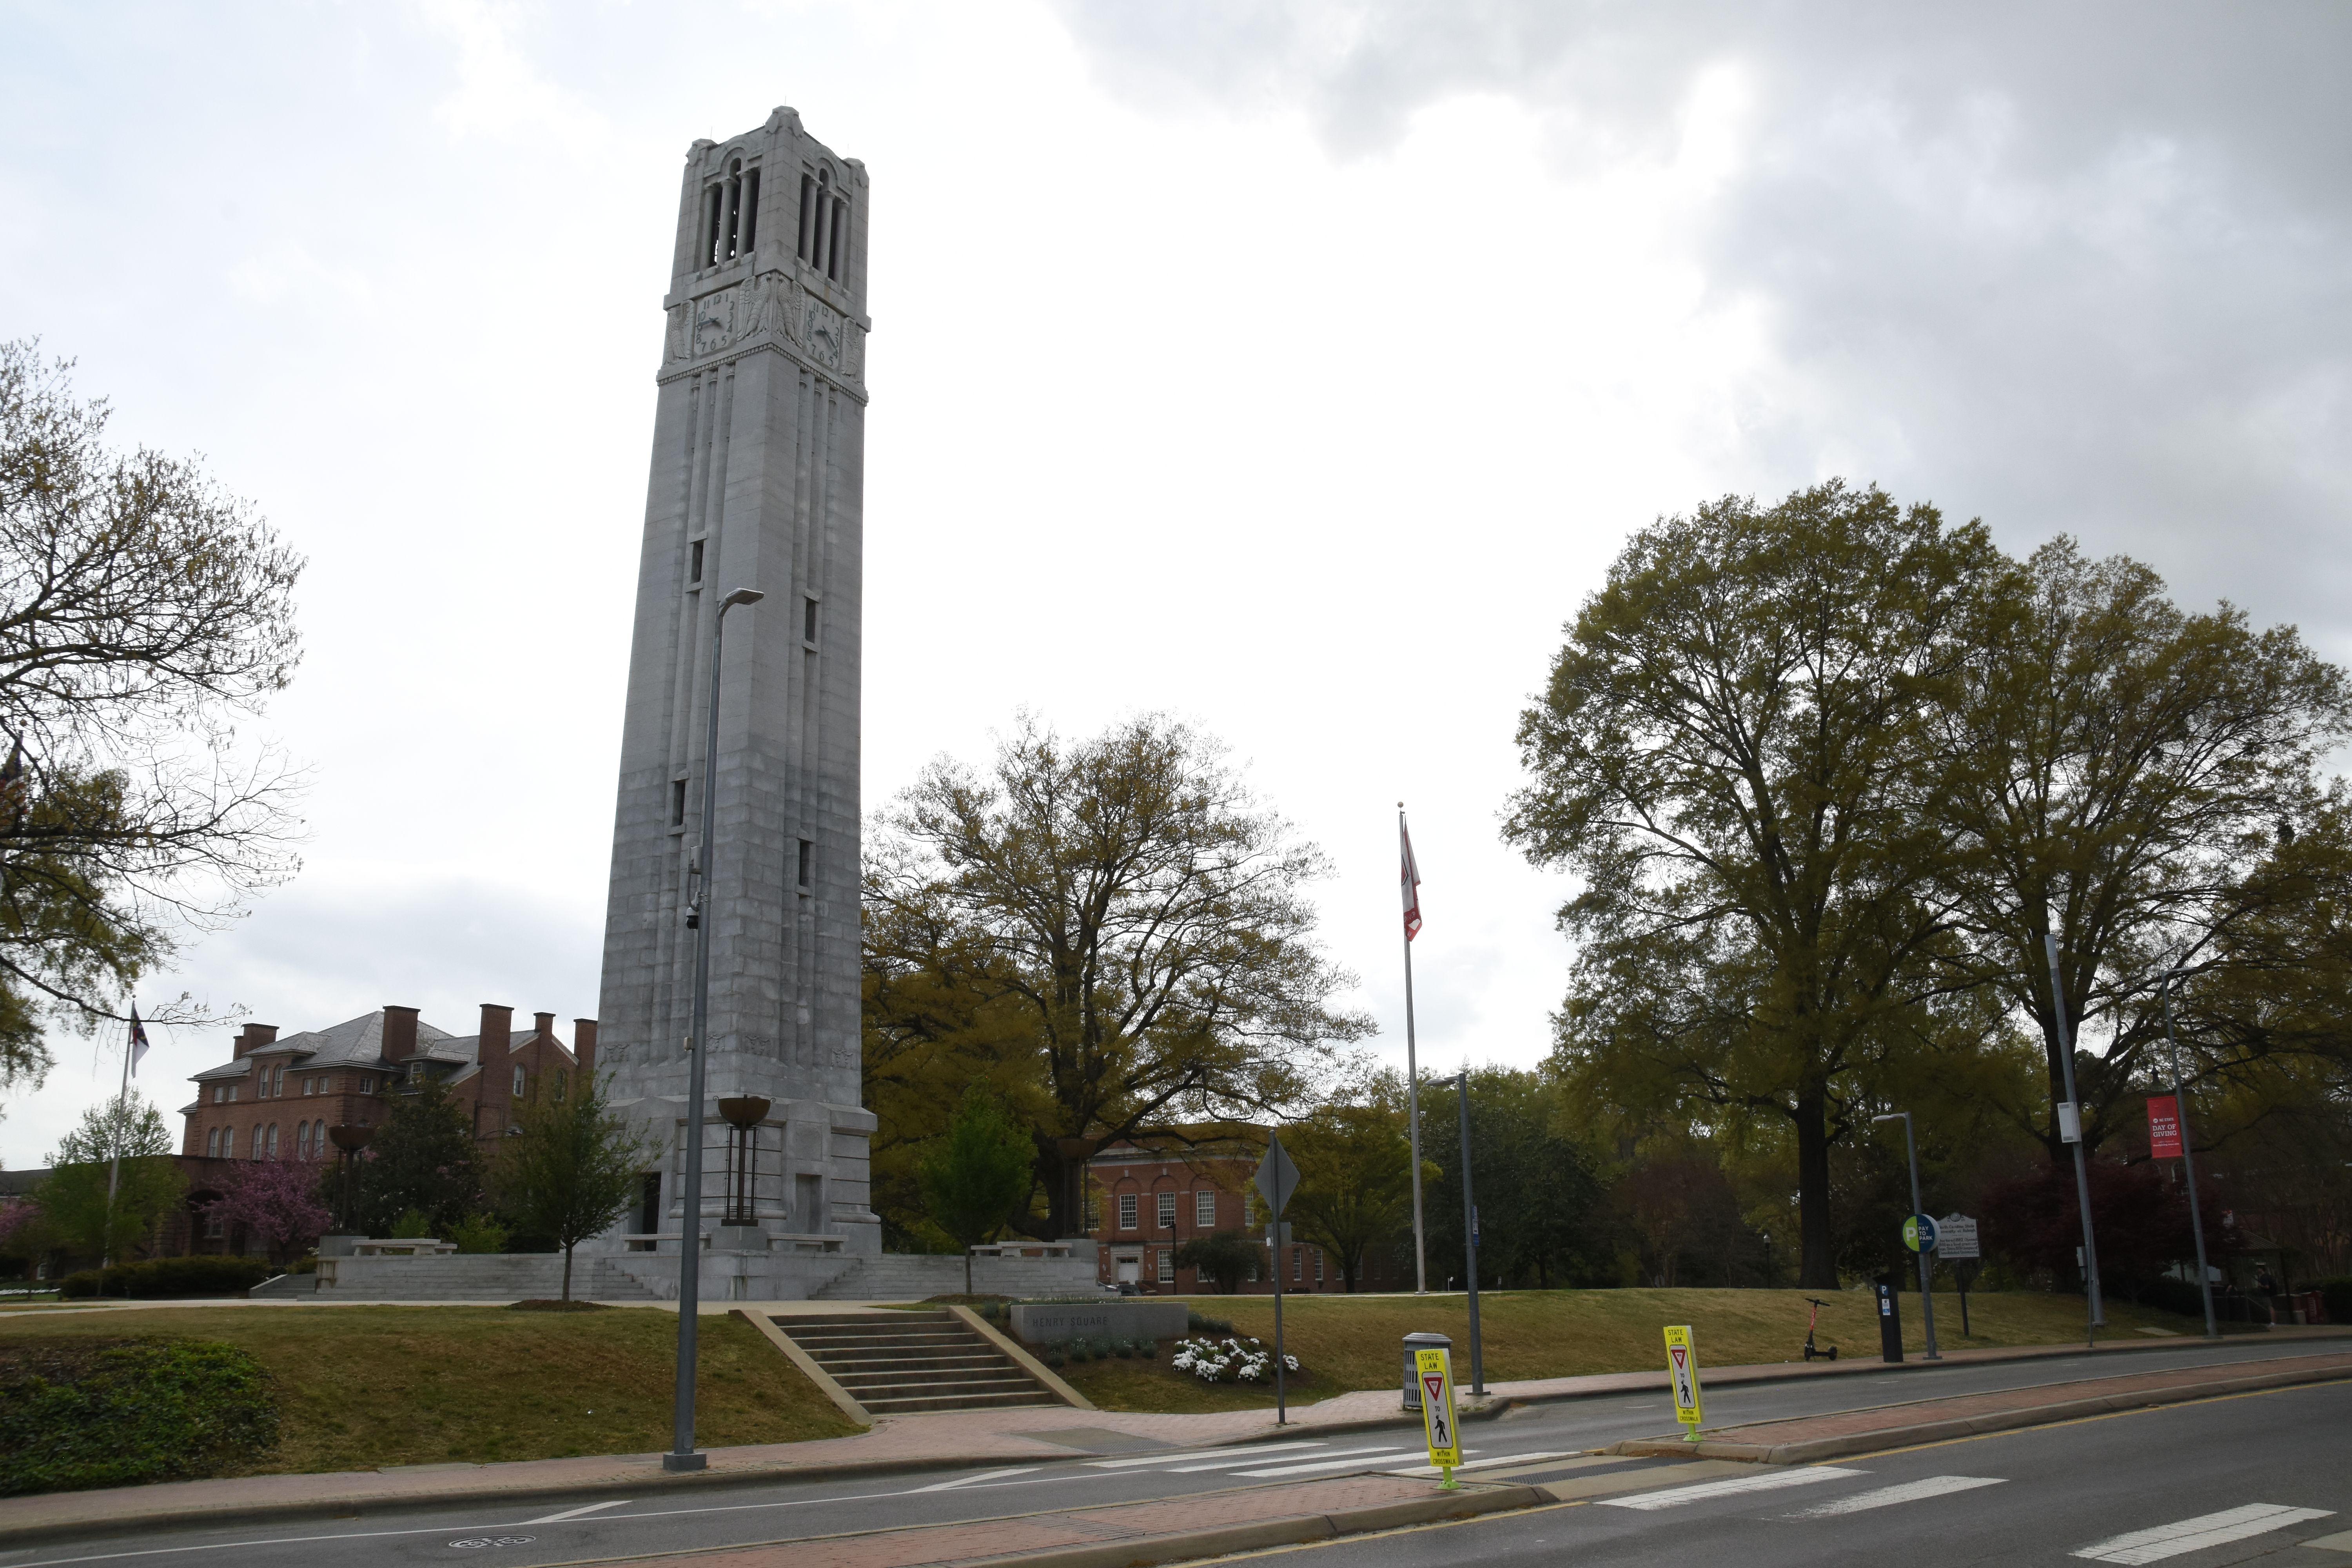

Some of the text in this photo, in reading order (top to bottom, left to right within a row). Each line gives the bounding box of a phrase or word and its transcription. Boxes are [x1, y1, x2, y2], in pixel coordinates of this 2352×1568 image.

[704, 299, 710, 310] 11
[713, 294, 721, 305] 12
[729, 301, 735, 310] 2
[813, 302, 818, 312] 11
[698, 311, 706, 321] 10
[728, 312, 733, 323] 3
[809, 310, 815, 321] 10
[822, 306, 828, 318] 12
[726, 323, 732, 332] 4
[835, 327, 839, 336] 2
[696, 334, 701, 344] 8
[721, 335, 726, 347] 5
[807, 331, 811, 341] 8
[701, 341, 706, 352] 7
[710, 339, 716, 350] 6
[835, 337, 839, 348] 3
[812, 344, 816, 355] 7
[833, 350, 838, 359] 4
[819, 351, 824, 361] 6
[829, 356, 833, 366] 5
[1906, 1227, 1916, 1241] P
[1882, 1286, 1887, 1294] P
[1033, 1316, 1107, 1327] HENRY SQUARE
